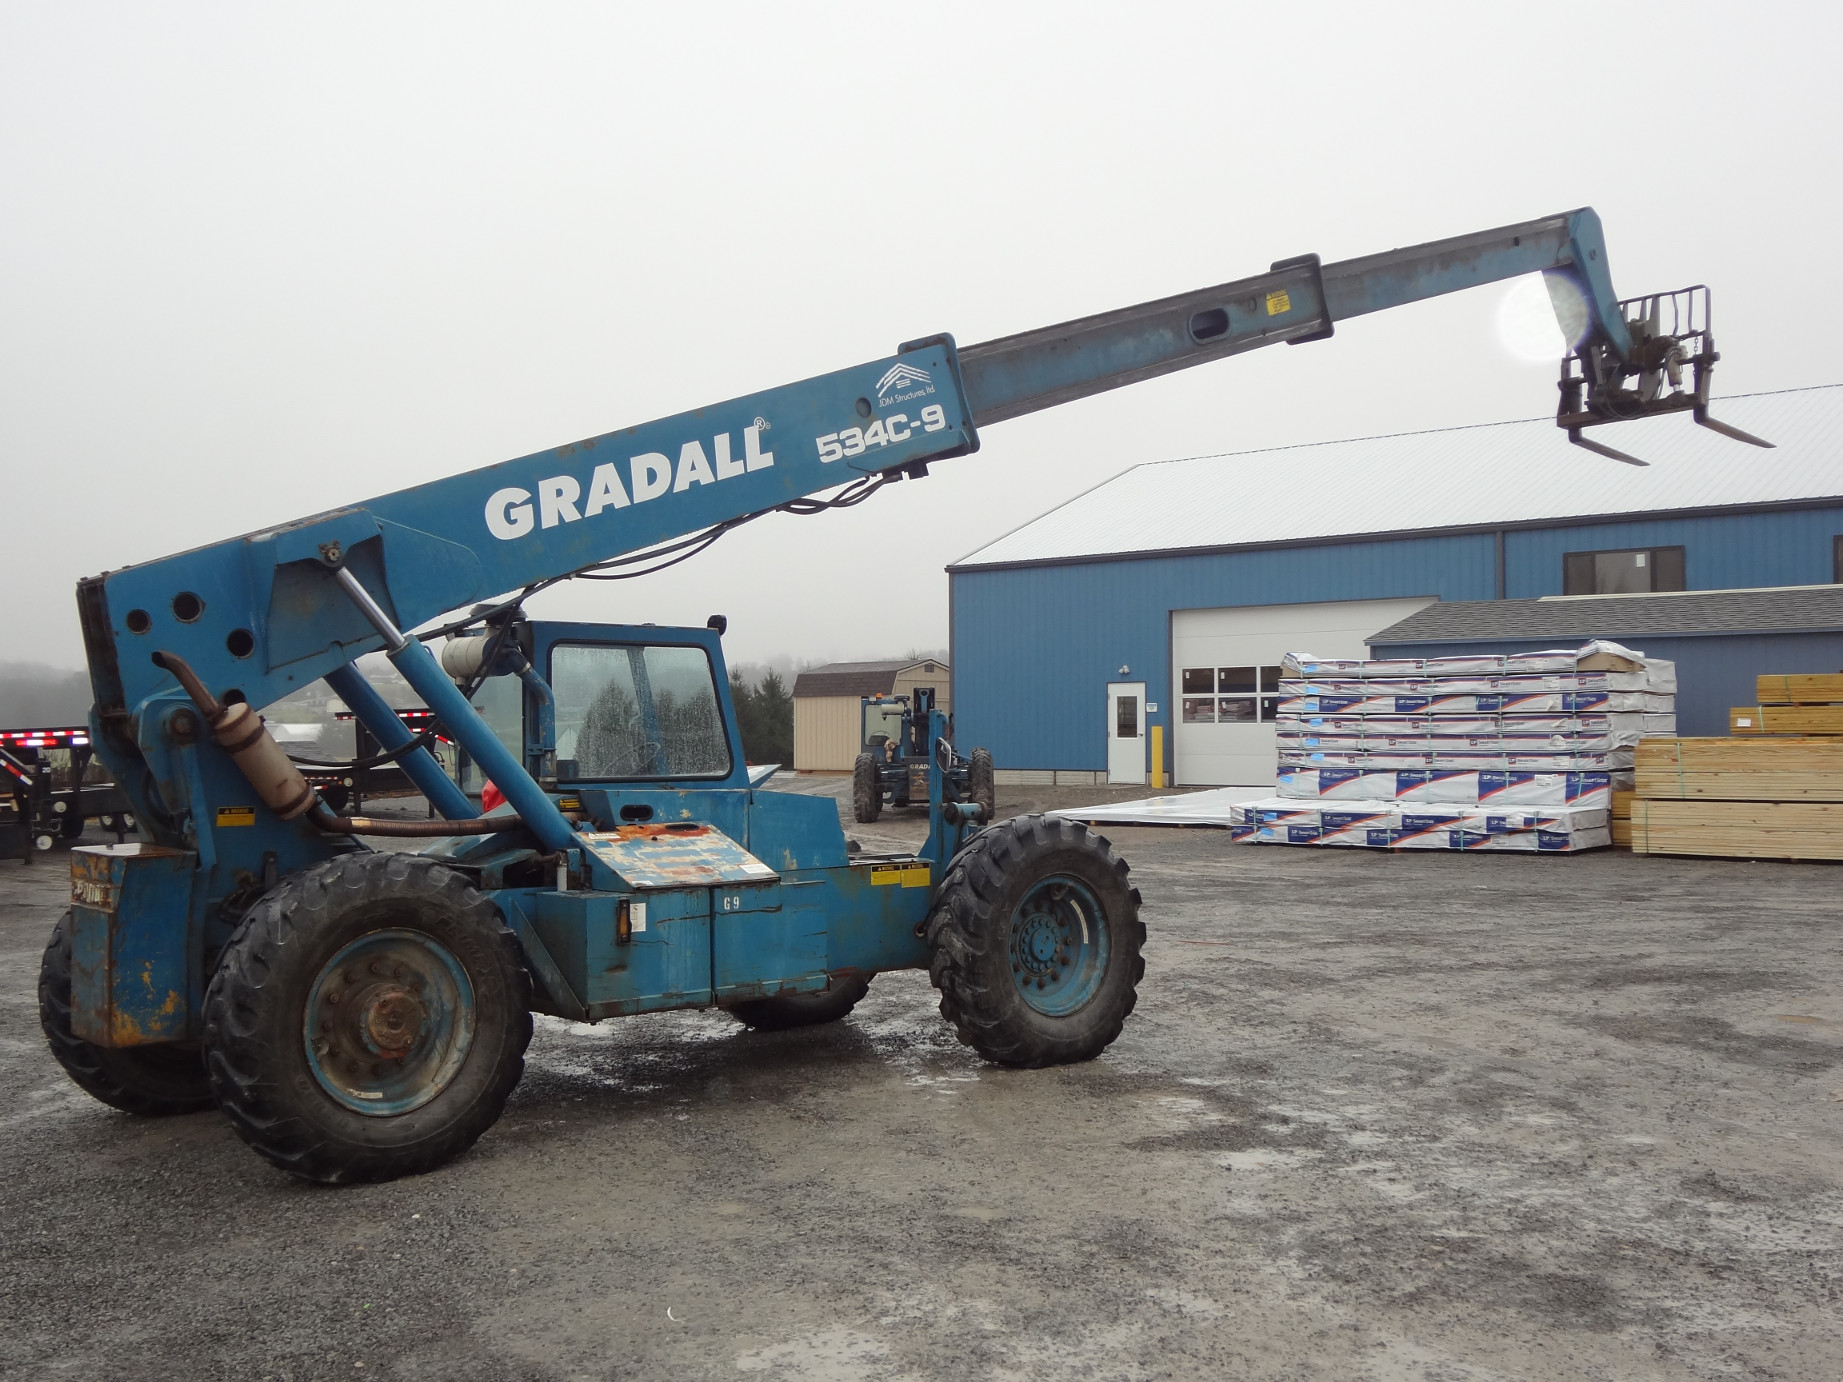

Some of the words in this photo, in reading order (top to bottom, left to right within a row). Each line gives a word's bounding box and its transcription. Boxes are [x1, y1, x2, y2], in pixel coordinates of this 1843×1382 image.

[879, 397, 894, 407] JDM
[815, 404, 946, 464] 534C-9
[484, 425, 775, 541] GRADALL
